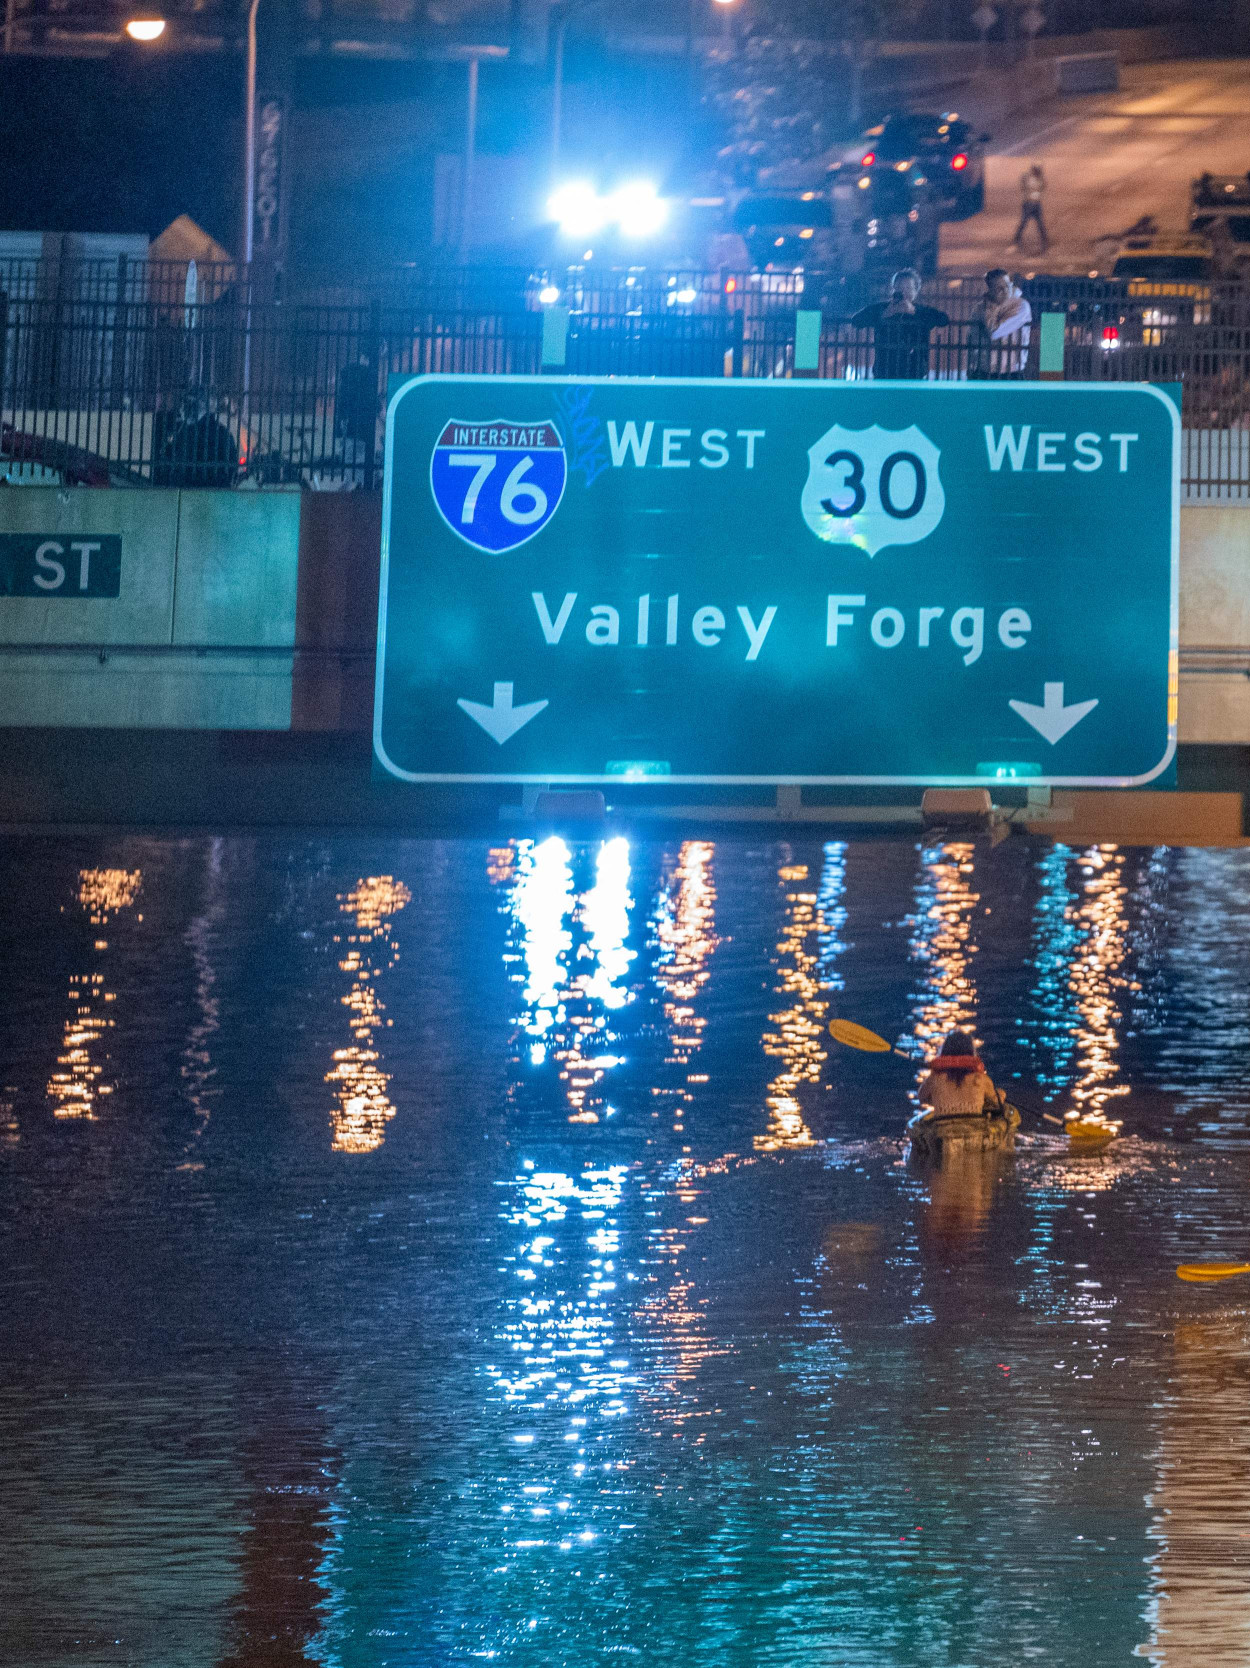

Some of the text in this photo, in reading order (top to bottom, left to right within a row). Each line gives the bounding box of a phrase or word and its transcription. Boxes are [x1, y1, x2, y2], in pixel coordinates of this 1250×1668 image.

[453, 428, 546, 447] INTERSTATE
[608, 421, 765, 467] WEST
[985, 426, 1138, 471] WEST
[447, 454, 549, 526] 76
[821, 450, 926, 519] 30
[33, 541, 101, 590] ST
[532, 593, 1031, 665] Valley Forge
